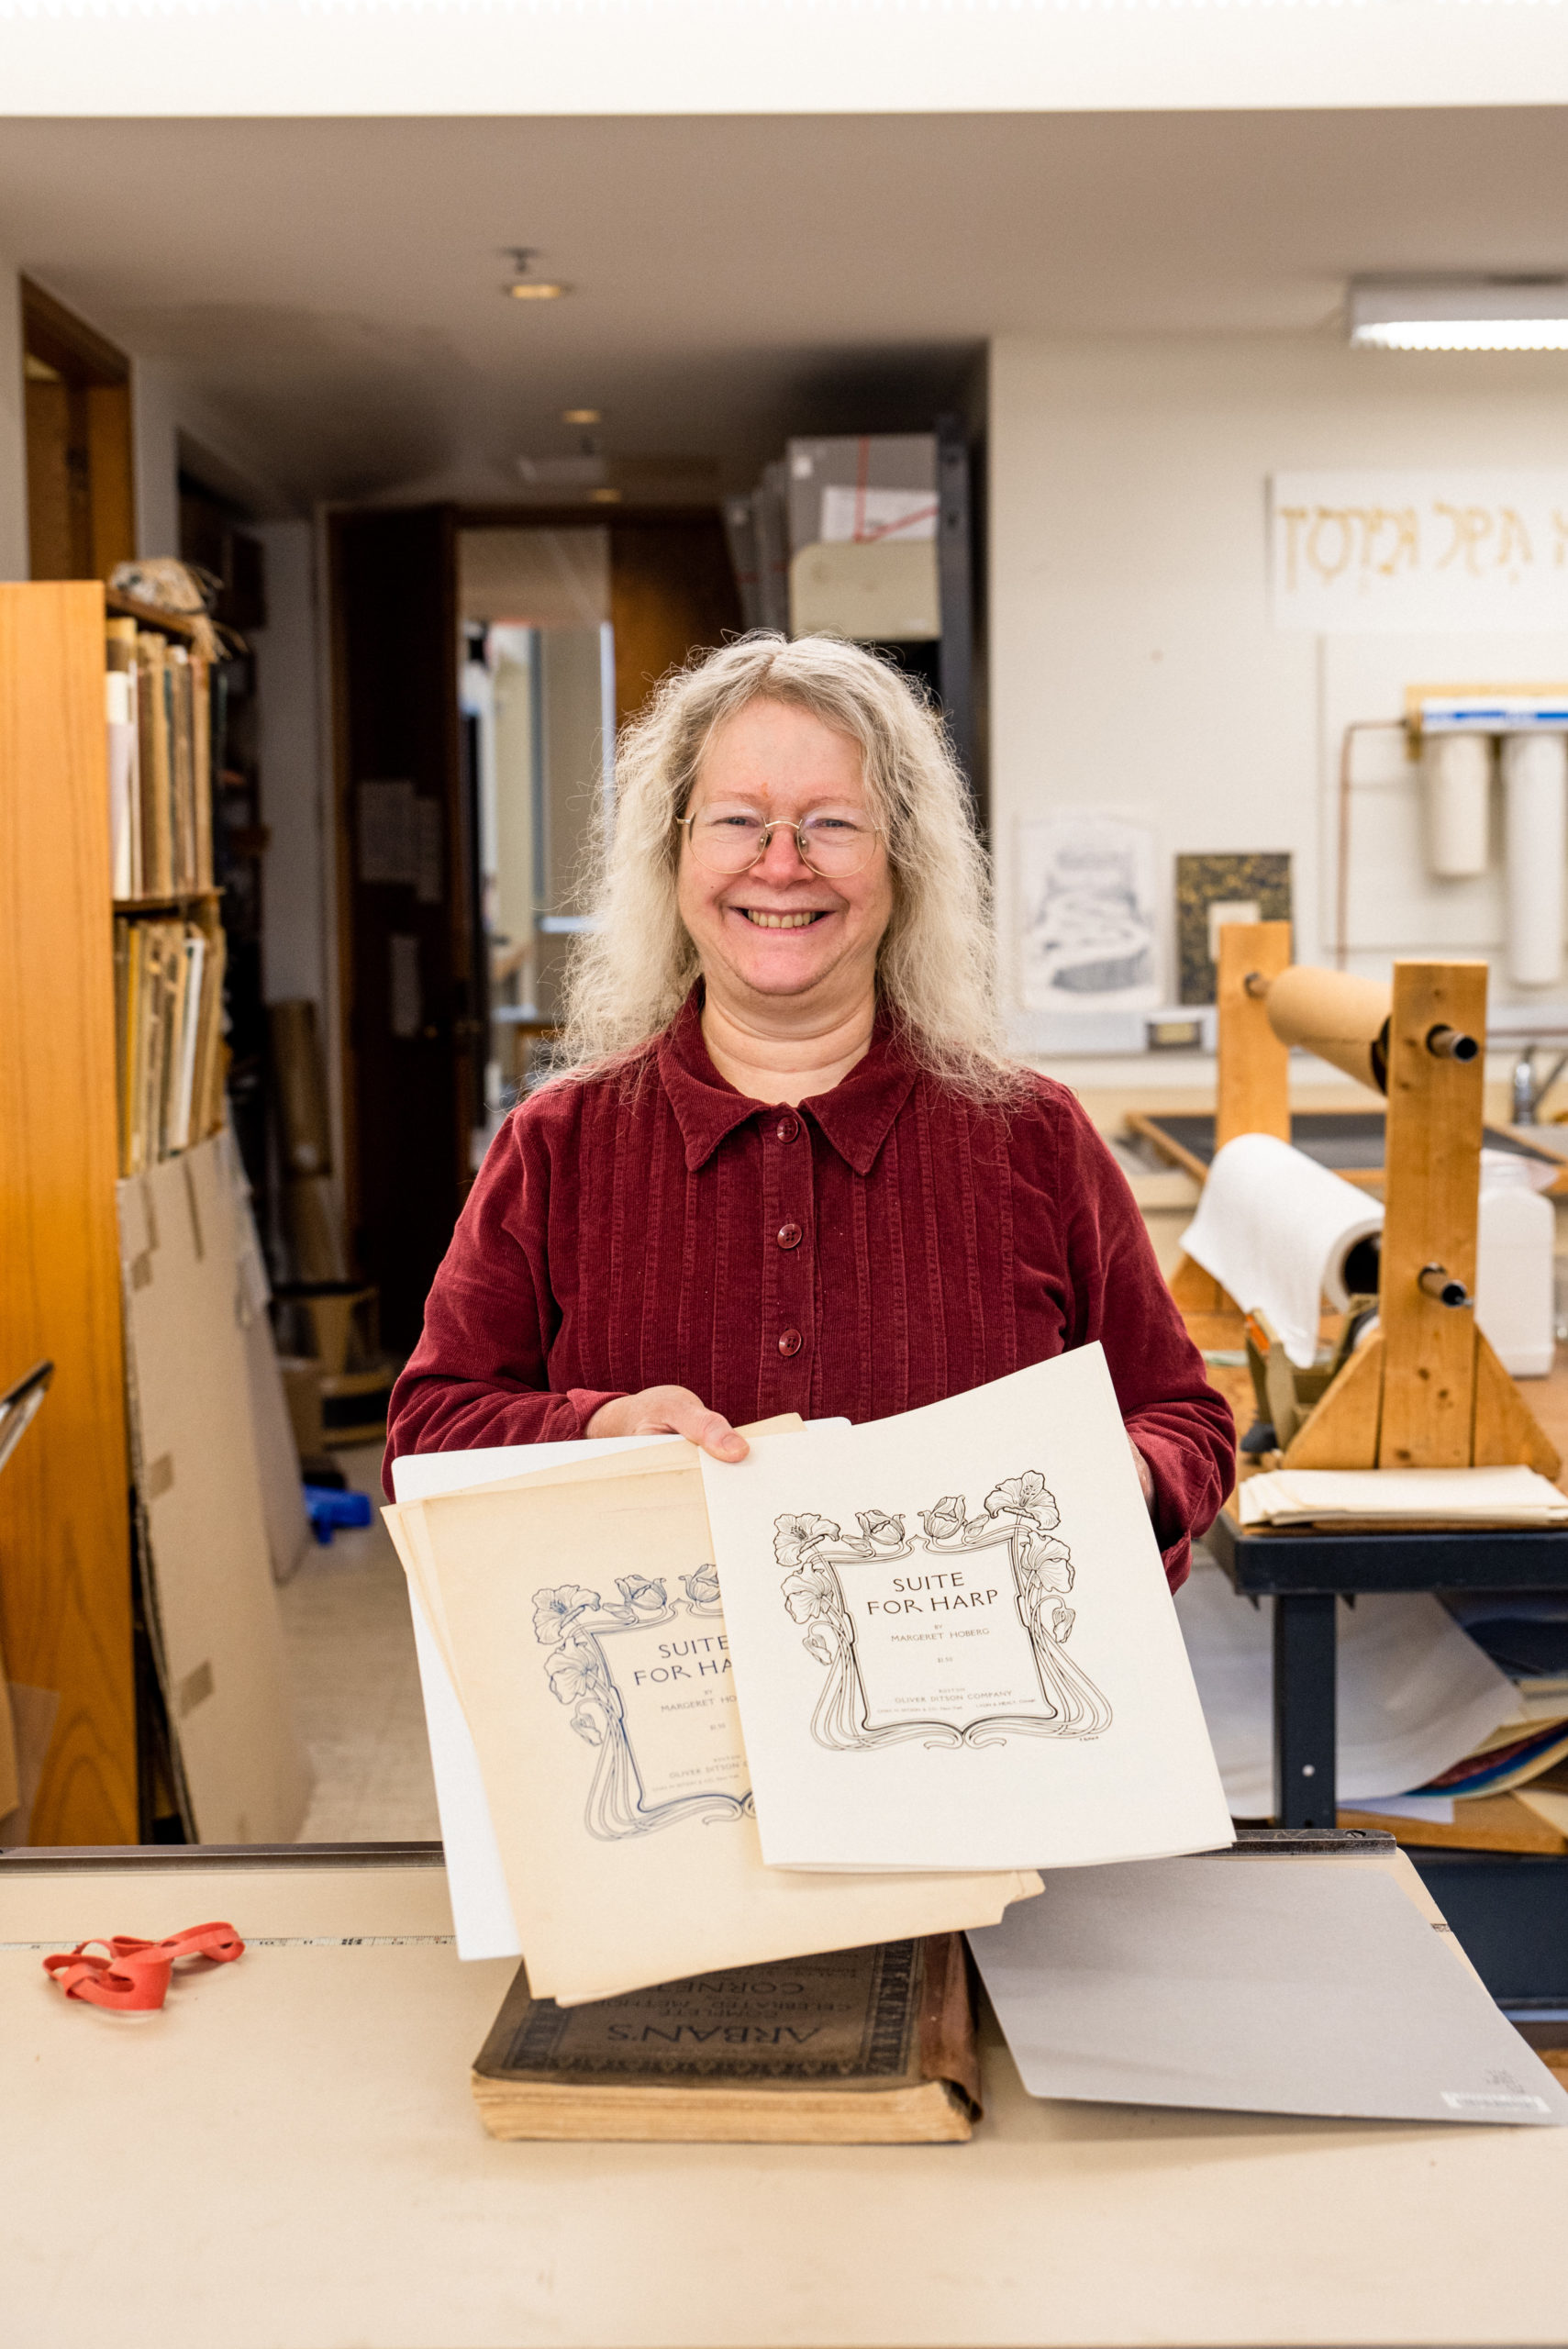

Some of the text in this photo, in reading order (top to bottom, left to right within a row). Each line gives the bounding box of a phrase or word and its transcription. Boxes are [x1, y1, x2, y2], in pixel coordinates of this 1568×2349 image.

[893, 1571, 965, 1592] SUITE
[866, 1589, 999, 1616] FOR HARP
[891, 1627, 991, 1642] MARGERET HOBERG
[658, 1634, 729, 1659] SUITE
[633, 1658, 732, 1686] FOR HA
[895, 1696, 927, 1704] OLIVER
[930, 1694, 964, 1703] DITSON
[966, 1689, 1013, 1701] COMPANY
[660, 1698, 715, 1713] MARGERET
[651, 1981, 805, 1995] CORNET
[710, 2000, 853, 2012] CELEBRATED
[606, 2024, 820, 2044] ARBAN'S
